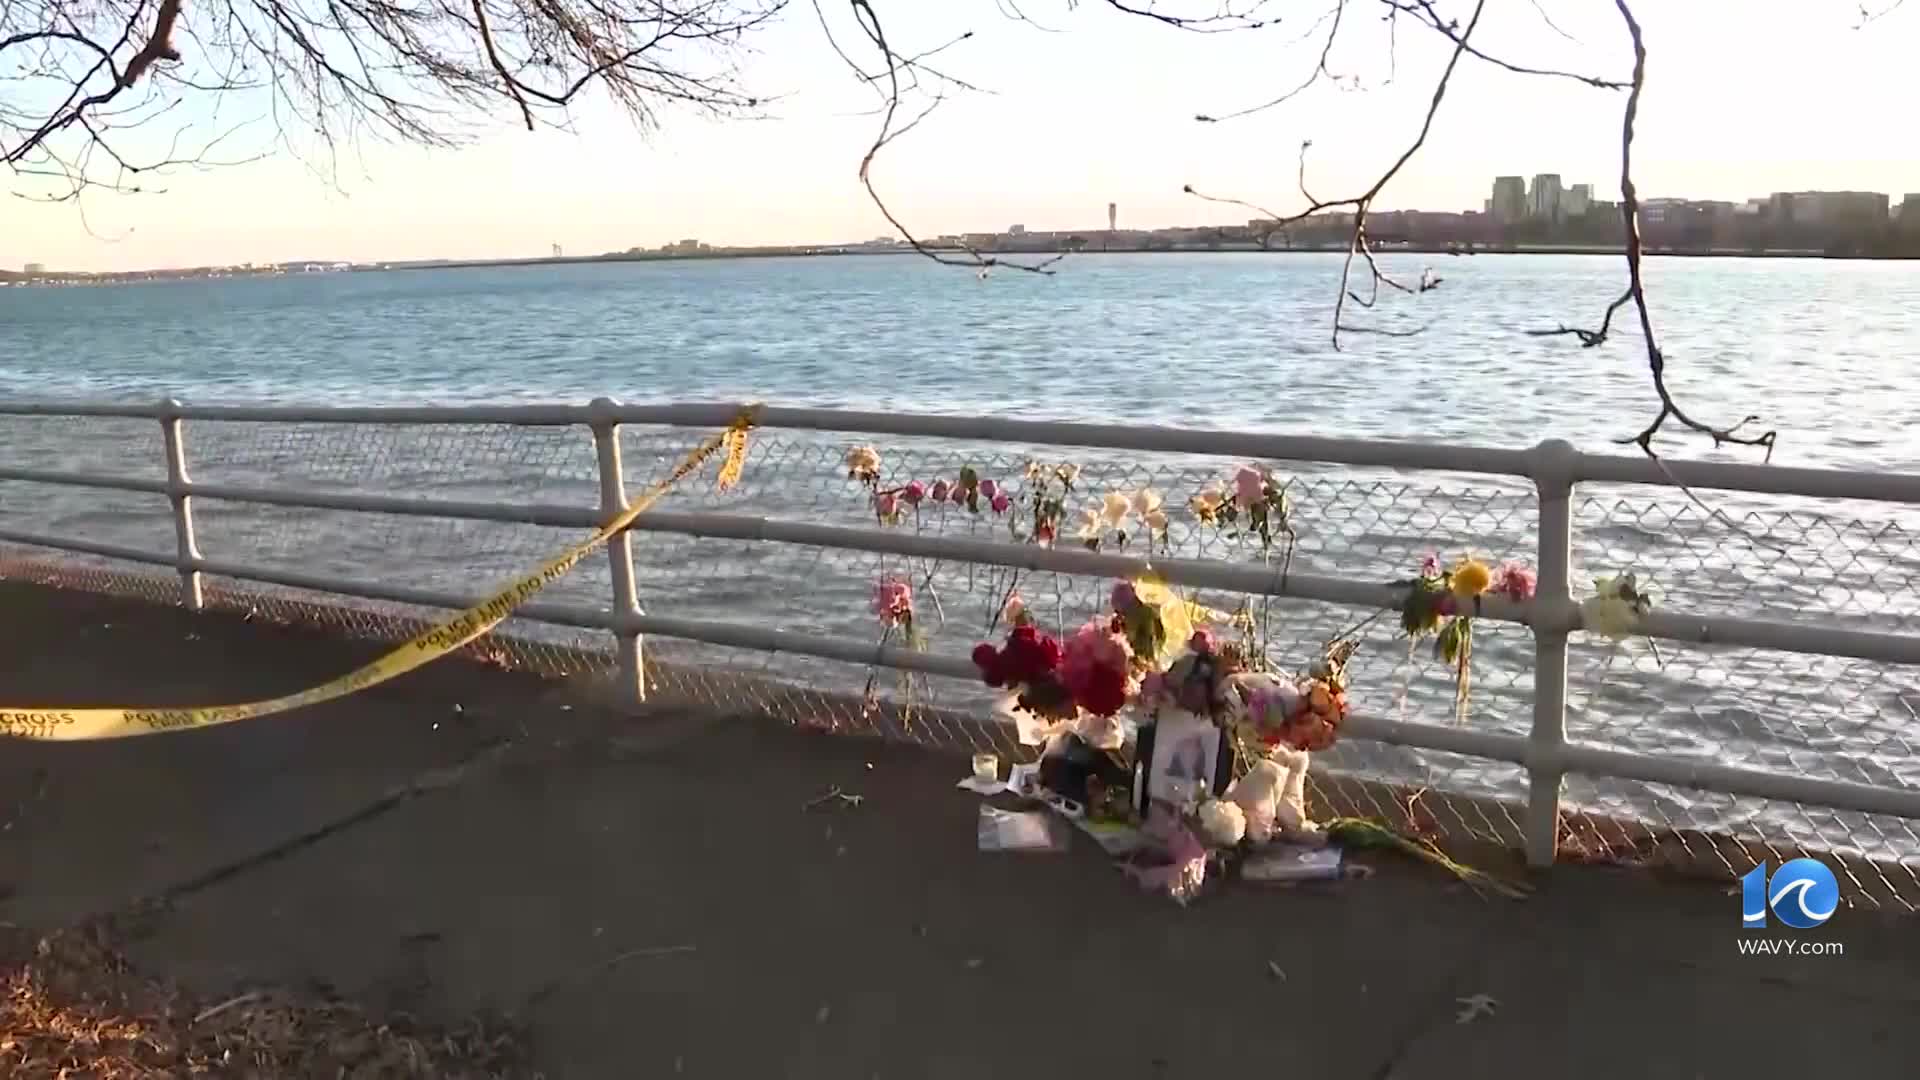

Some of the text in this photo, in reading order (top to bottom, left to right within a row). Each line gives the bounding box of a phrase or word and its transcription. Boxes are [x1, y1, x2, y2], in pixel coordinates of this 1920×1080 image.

[516, 576, 541, 598] DO
[544, 557, 572, 582] NOT
[0, 713, 75, 724] CROSS
